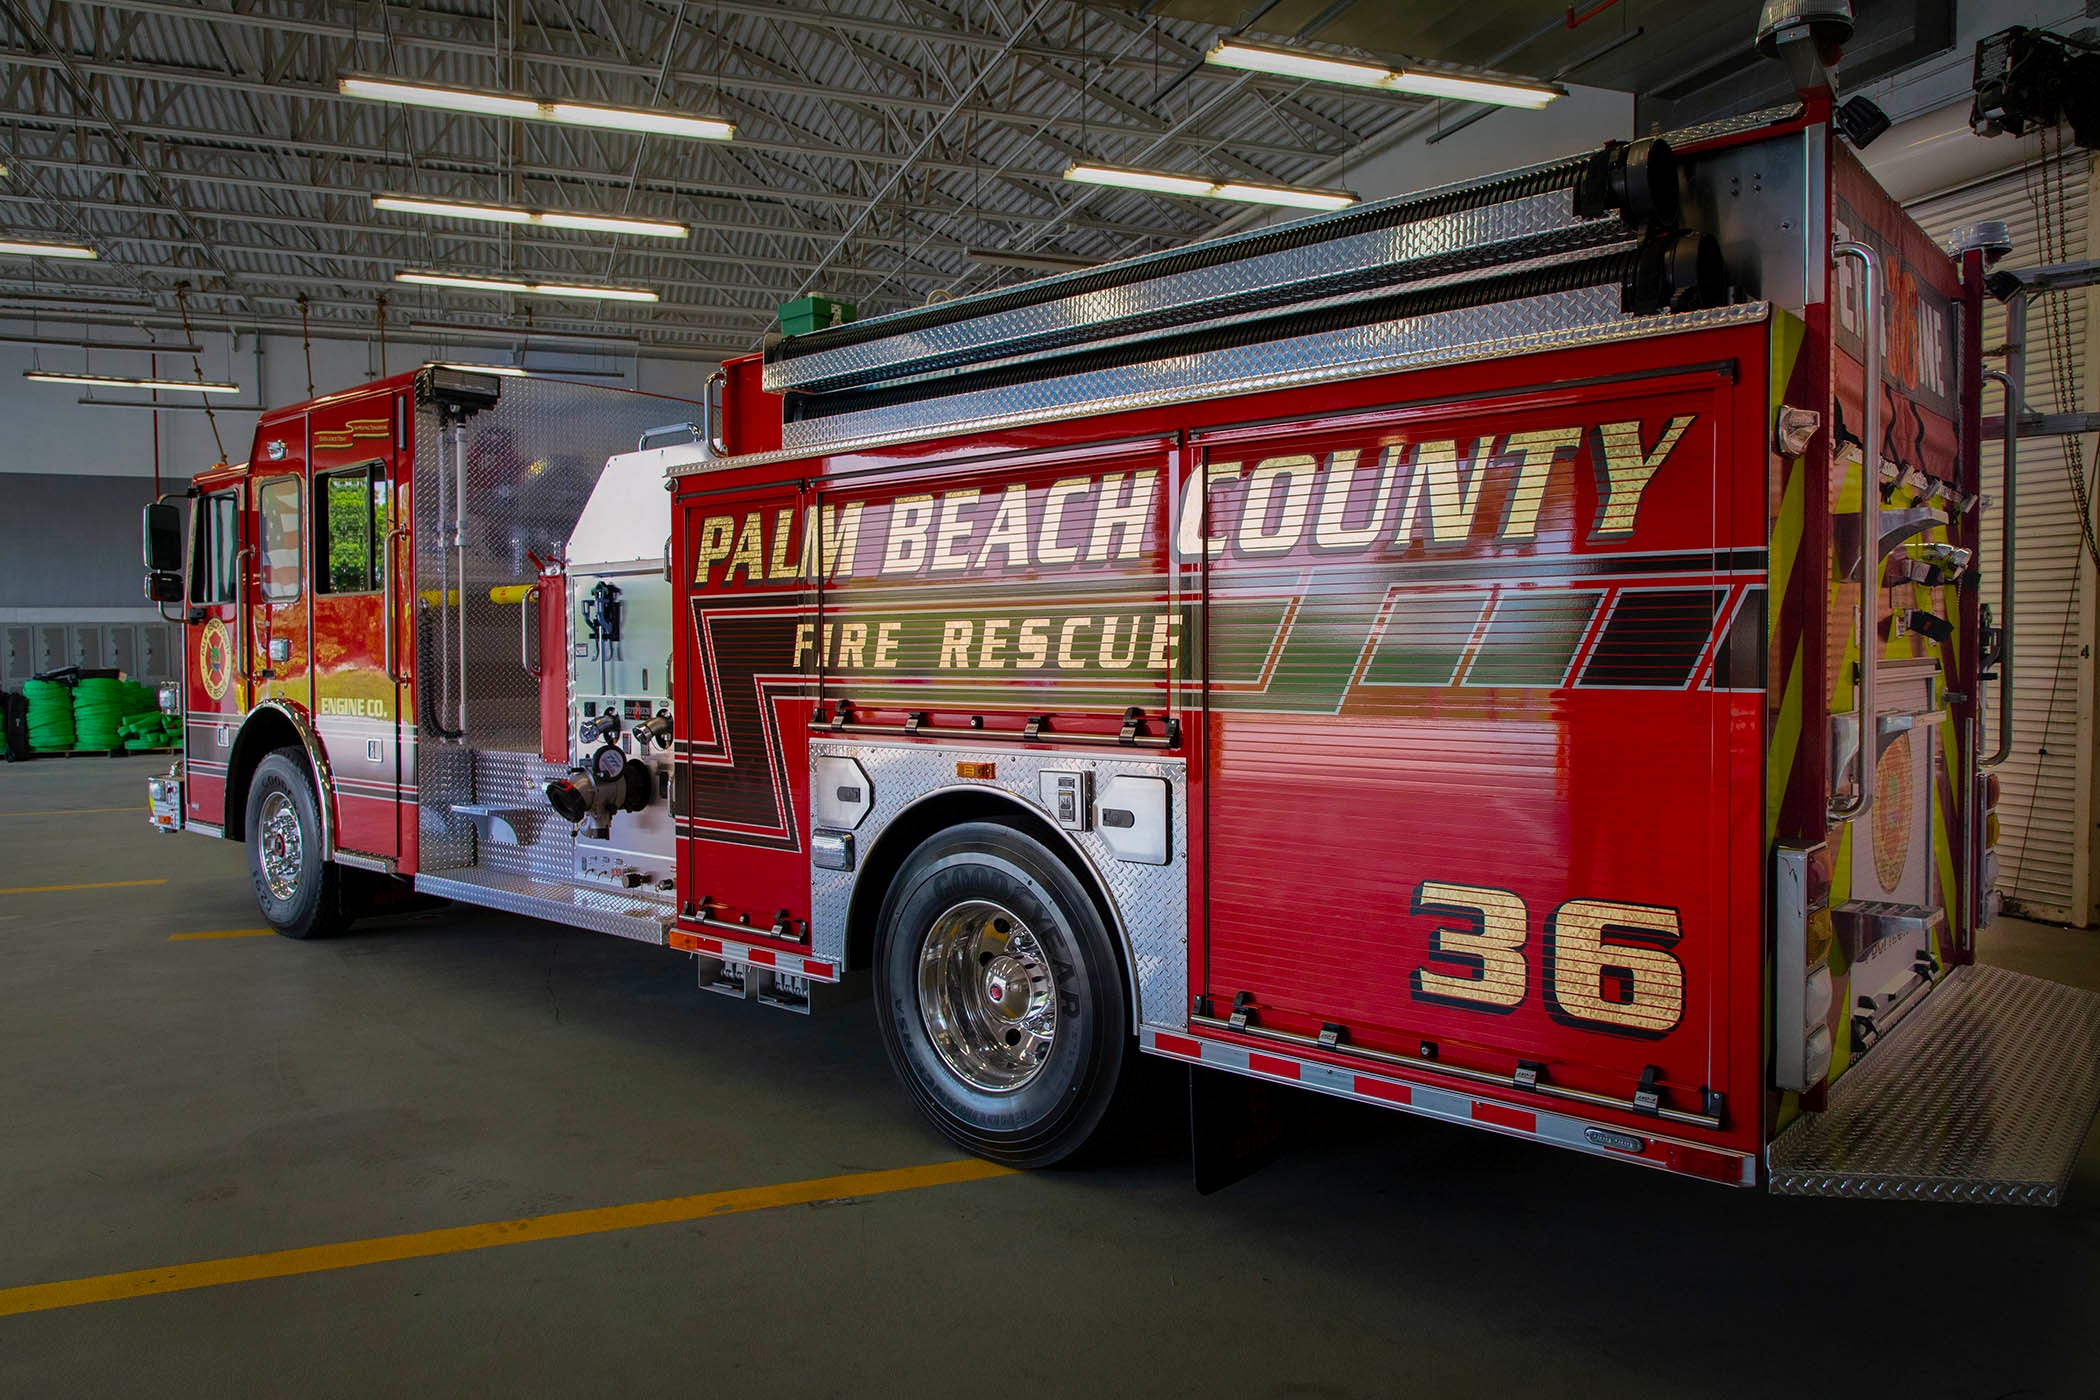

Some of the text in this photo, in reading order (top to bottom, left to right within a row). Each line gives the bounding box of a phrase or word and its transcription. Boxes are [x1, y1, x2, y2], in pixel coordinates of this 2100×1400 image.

[694, 414, 1697, 585] PALM BEACH COUNTY
[792, 613, 1183, 670] FIRE RESCUE
[320, 697, 388, 718] ENGINE CO.
[1415, 881, 1683, 1032] 36
